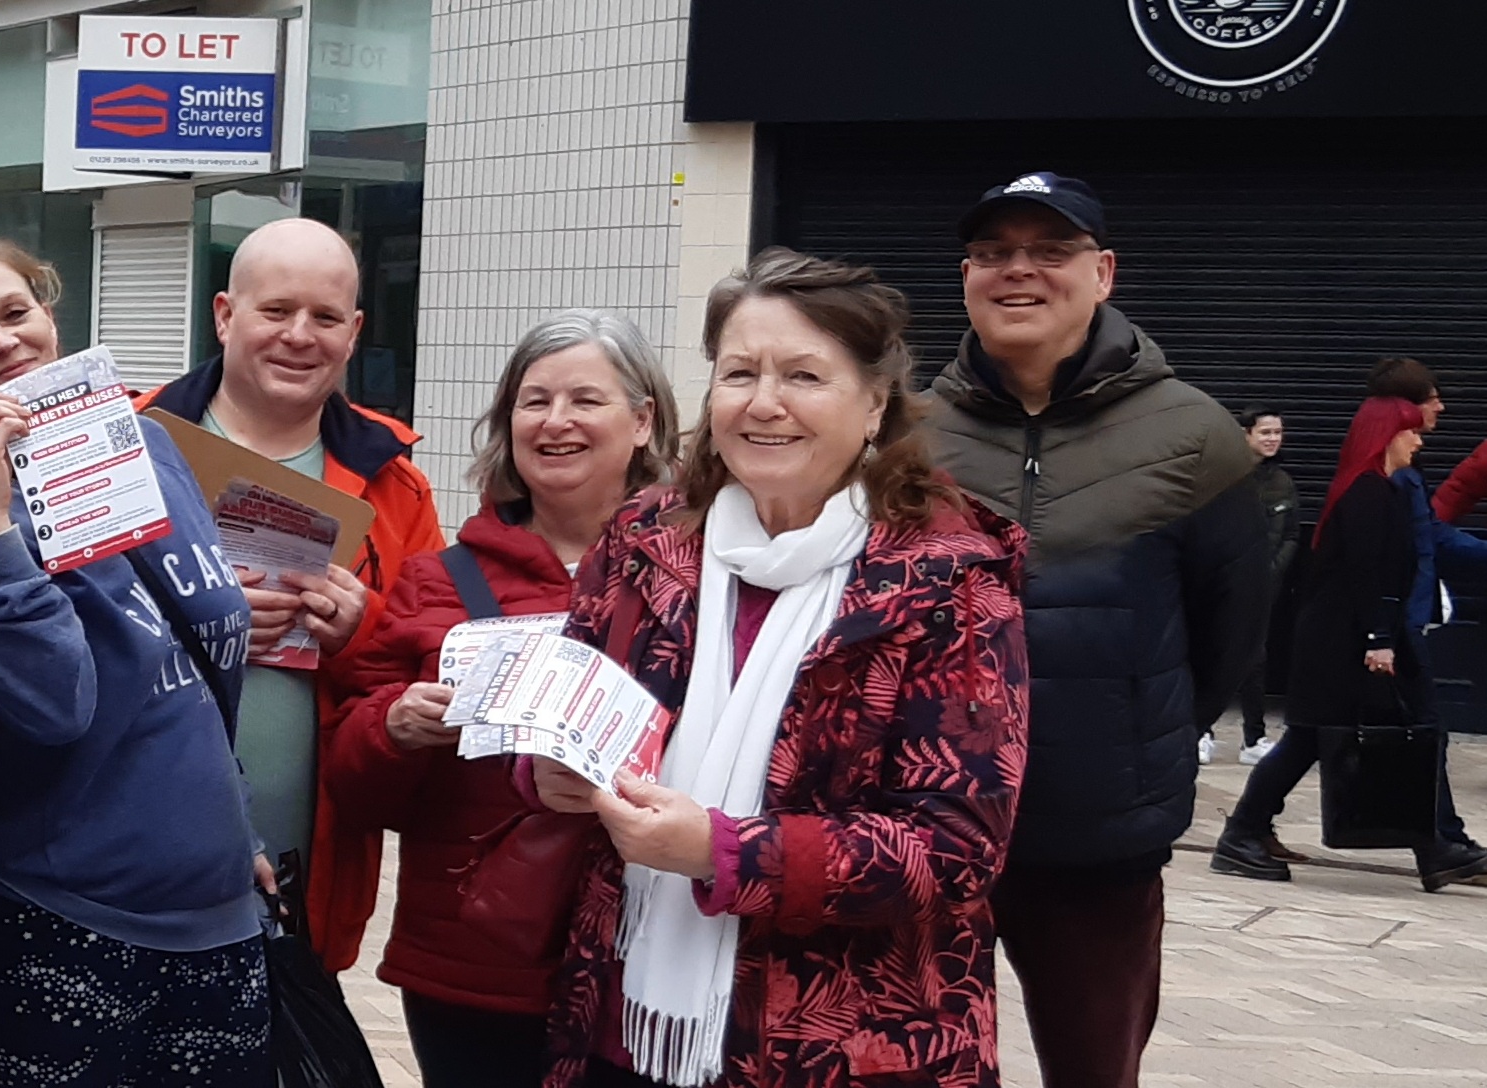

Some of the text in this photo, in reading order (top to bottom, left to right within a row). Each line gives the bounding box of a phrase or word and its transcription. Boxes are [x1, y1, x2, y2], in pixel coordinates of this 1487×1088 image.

[1192, 16, 1276, 40] COFFEE
[121, 32, 240, 60] TO LET
[1147, 64, 1232, 103] ESPRESSO
[178, 84, 264, 109] Smiths
[177, 107, 263, 123] Chartered
[177, 122, 263, 139] Surveyors
[1003, 183, 1051, 194] adidas
[39, 401, 85, 425] BETTER
[85, 386, 123, 406] BUSES
[42, 395, 58, 407] TO
[57, 385, 88, 401] HELP
